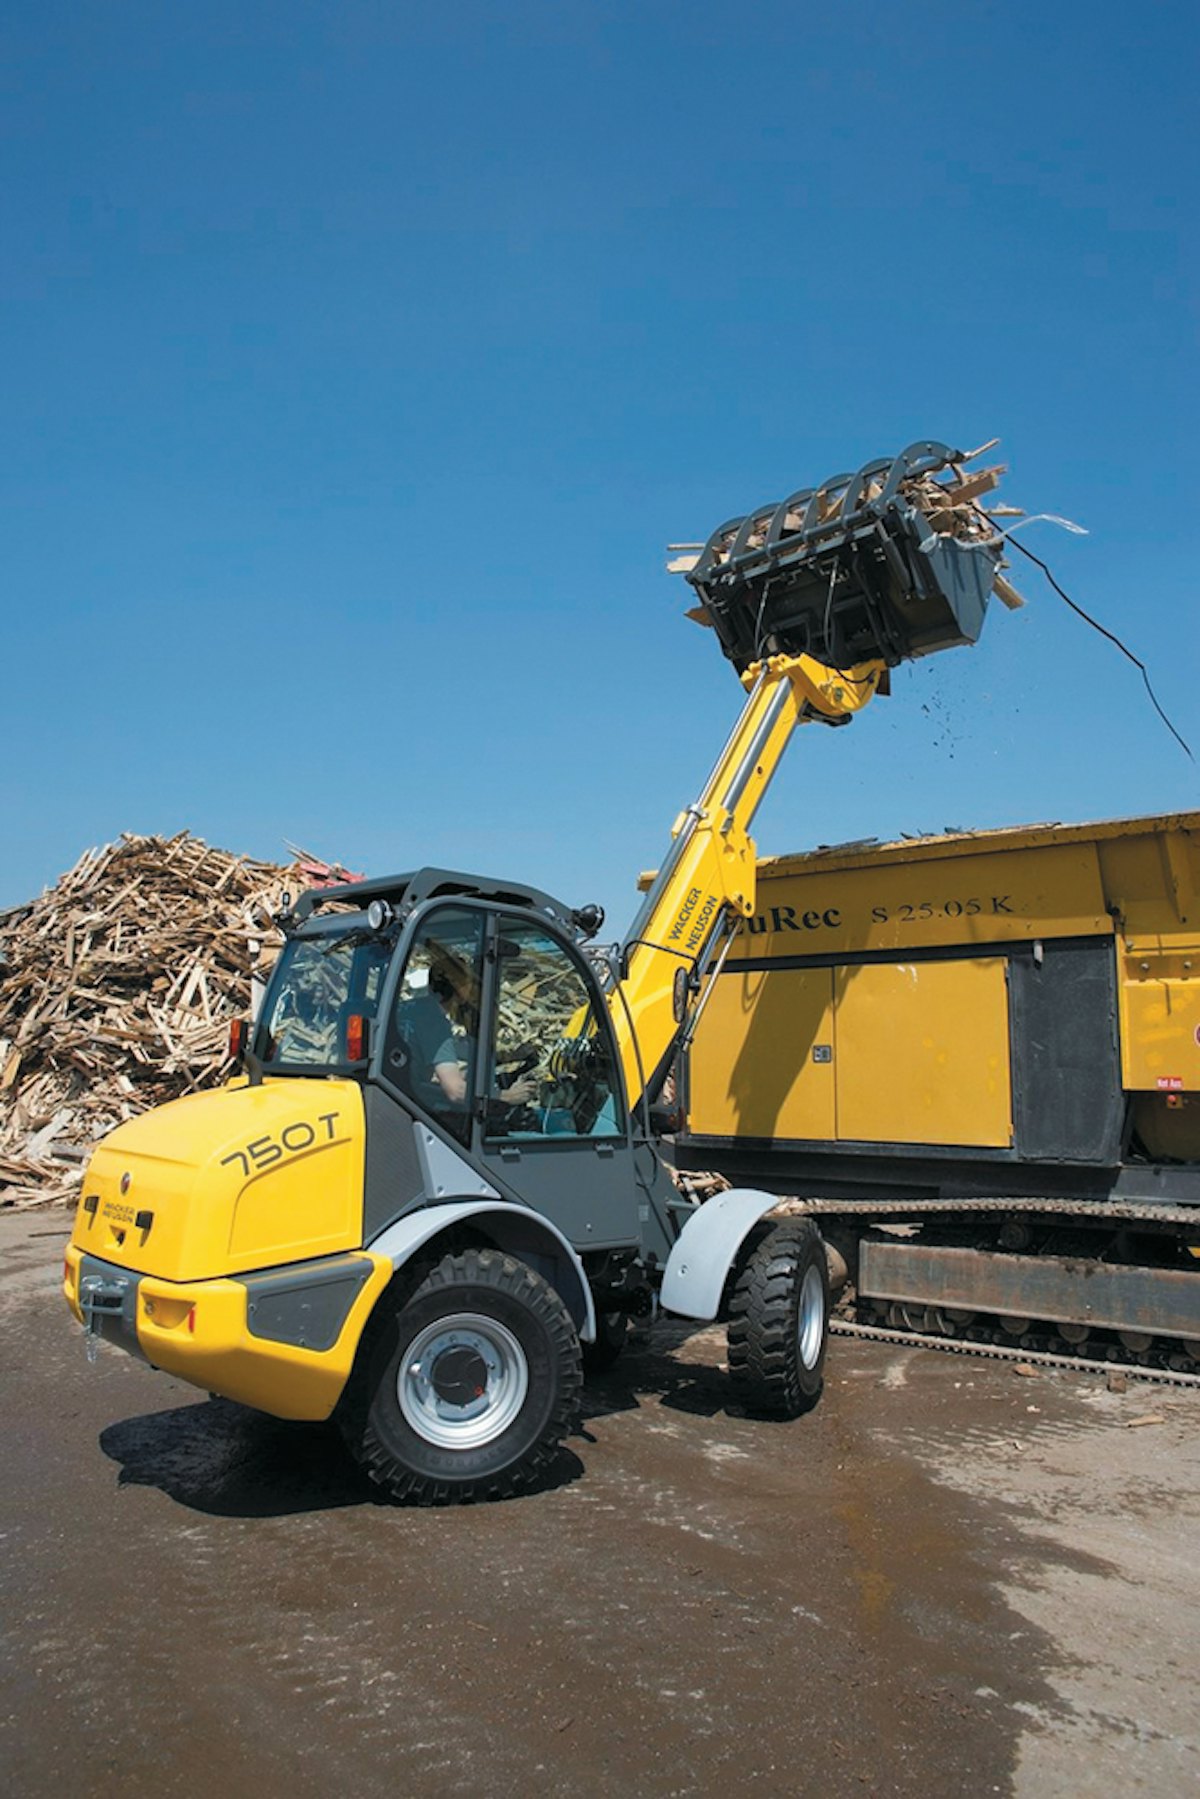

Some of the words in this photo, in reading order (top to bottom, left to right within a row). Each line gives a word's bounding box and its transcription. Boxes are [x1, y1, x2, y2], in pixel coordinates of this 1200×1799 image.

[668, 888, 702, 940] WACKER
[686, 895, 718, 950] NEUSON
[872, 906, 889, 924] S
[898, 898, 982, 922] 25.05
[992, 895, 1014, 915] K
